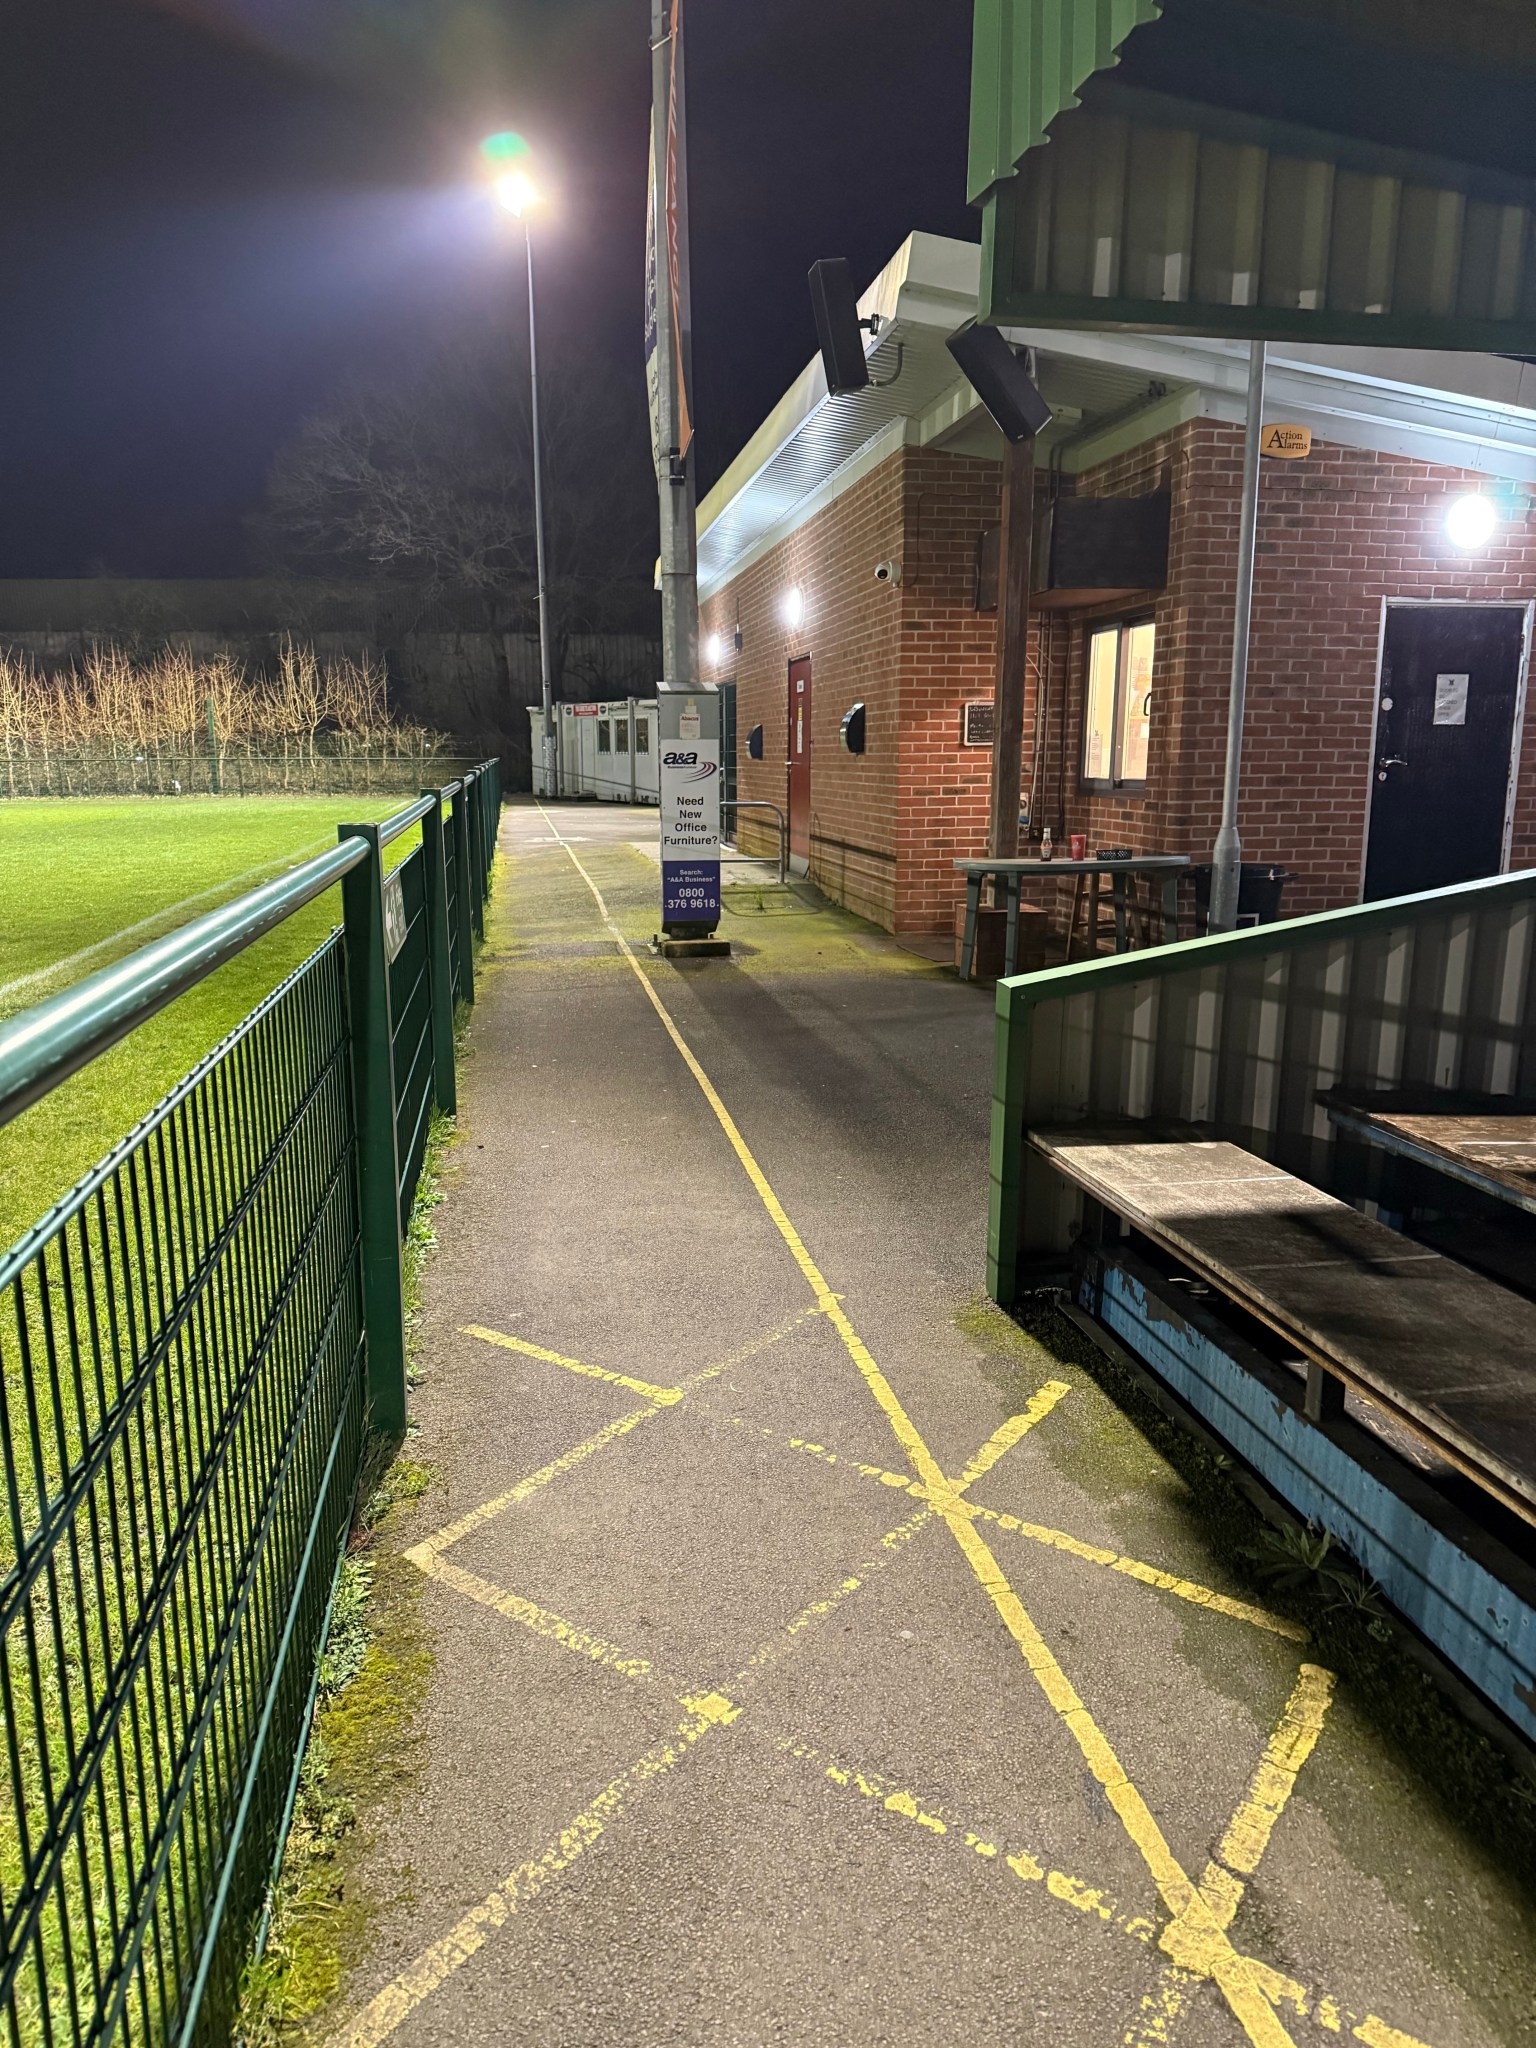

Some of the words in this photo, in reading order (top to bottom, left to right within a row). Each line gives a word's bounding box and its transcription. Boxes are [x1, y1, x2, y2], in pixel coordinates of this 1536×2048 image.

[1267, 429, 1303, 448] Action
[663, 752, 698, 765] a&a
[677, 796, 704, 806] Need
[679, 809, 702, 819] New
[675, 822, 707, 832] Office
[664, 835, 718, 845] Furniture?
[678, 888, 705, 898] 0800
[667, 899, 687, 909] 376
[690, 898, 716, 909] 9618
